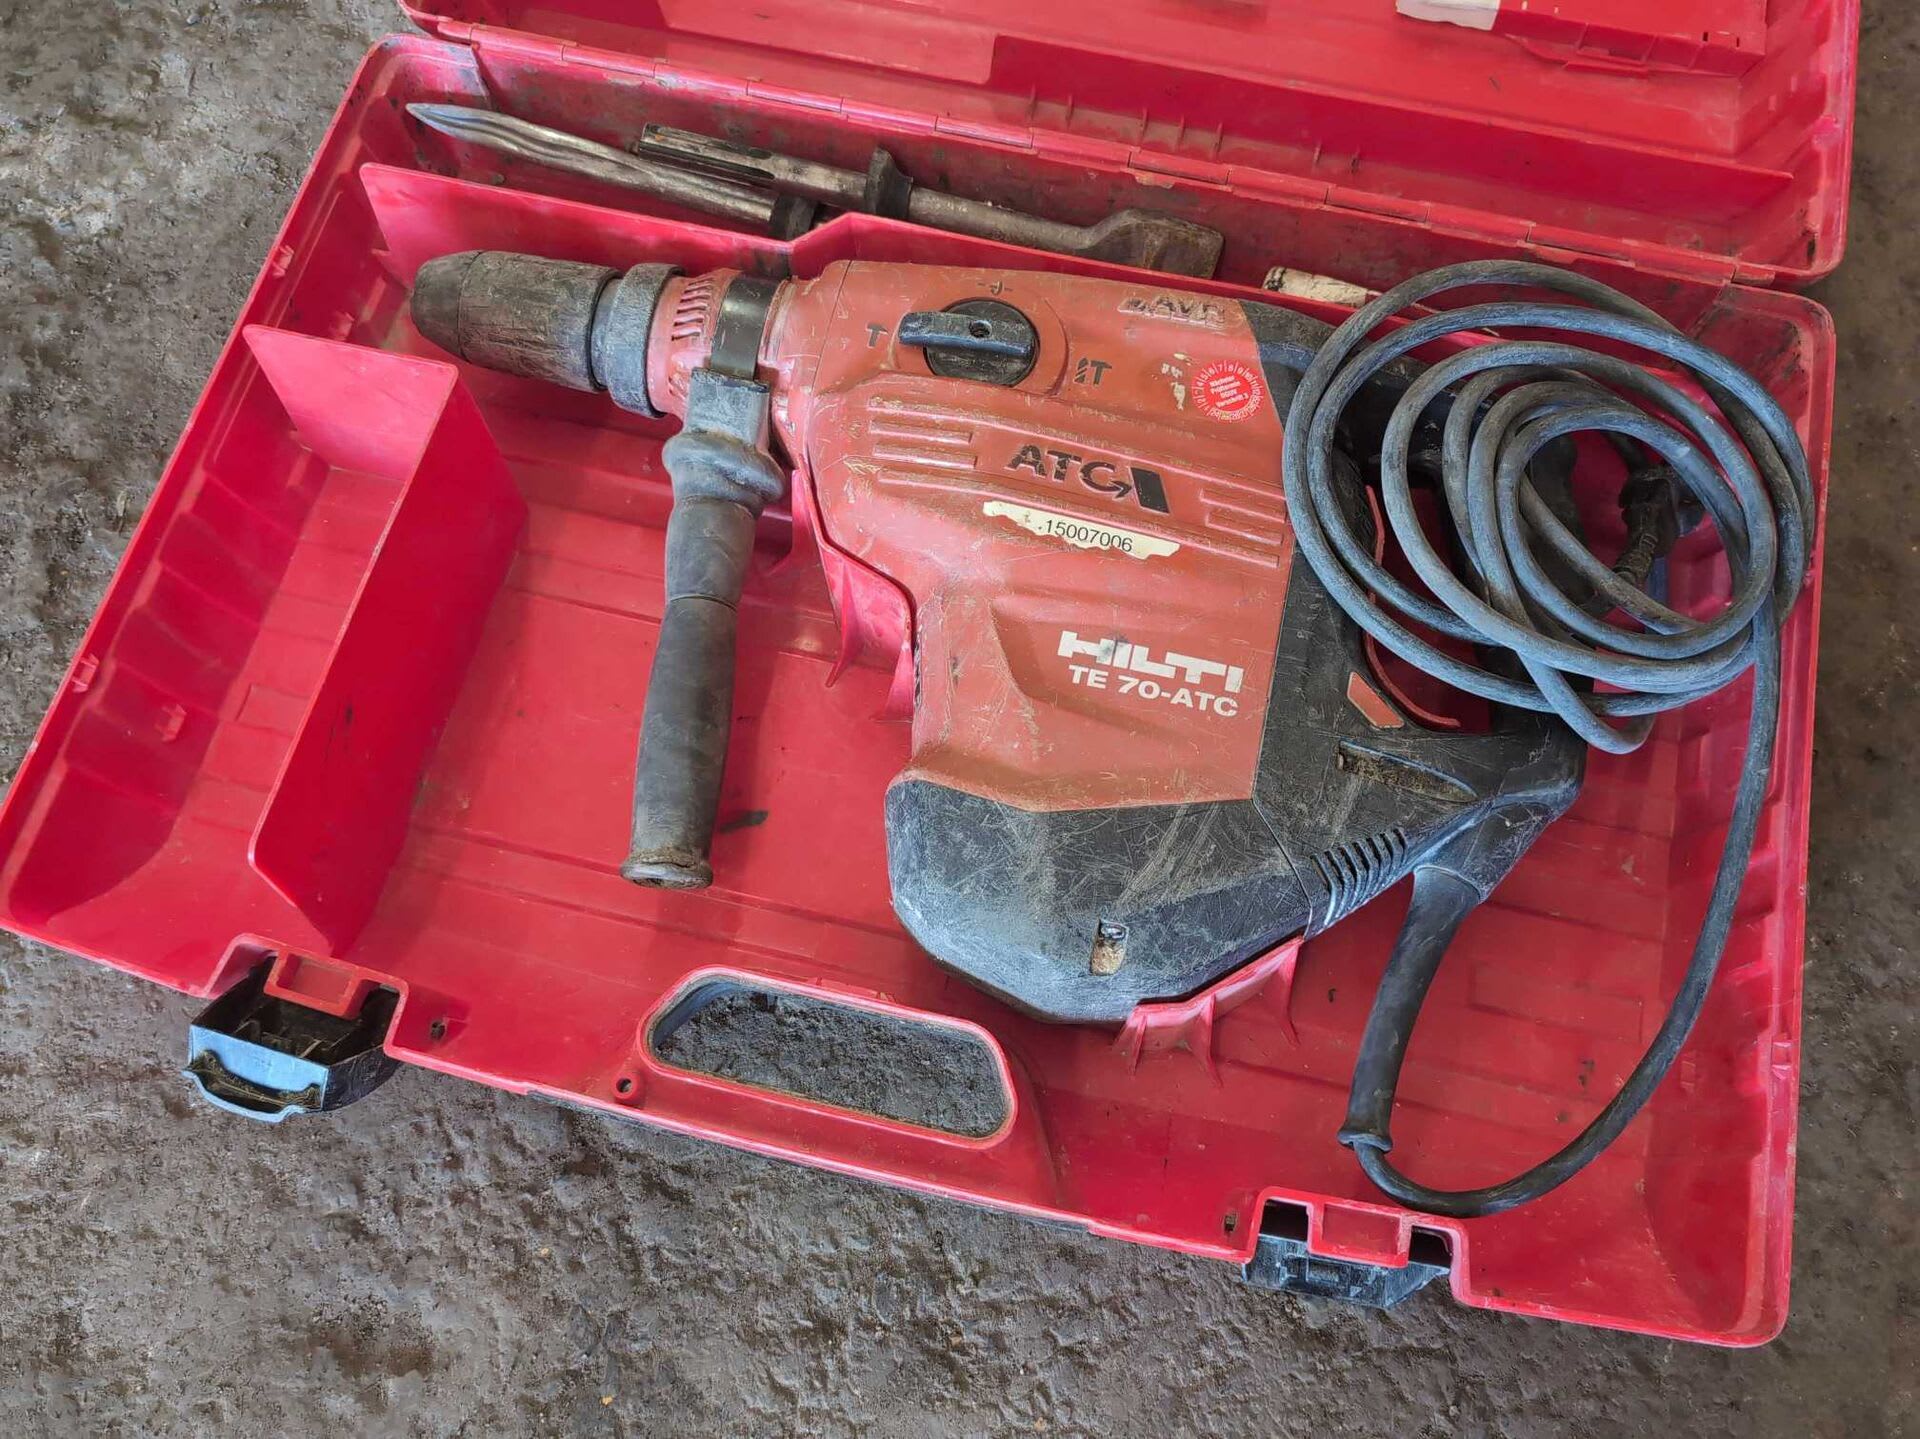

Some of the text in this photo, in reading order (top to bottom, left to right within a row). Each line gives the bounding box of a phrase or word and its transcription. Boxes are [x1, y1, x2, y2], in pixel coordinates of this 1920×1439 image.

[1004, 444, 1133, 500] ATC
[1045, 518, 1133, 553] 15007006
[1057, 630, 1244, 693] HILTI
[1068, 664, 1239, 717] TE 70-ATC
